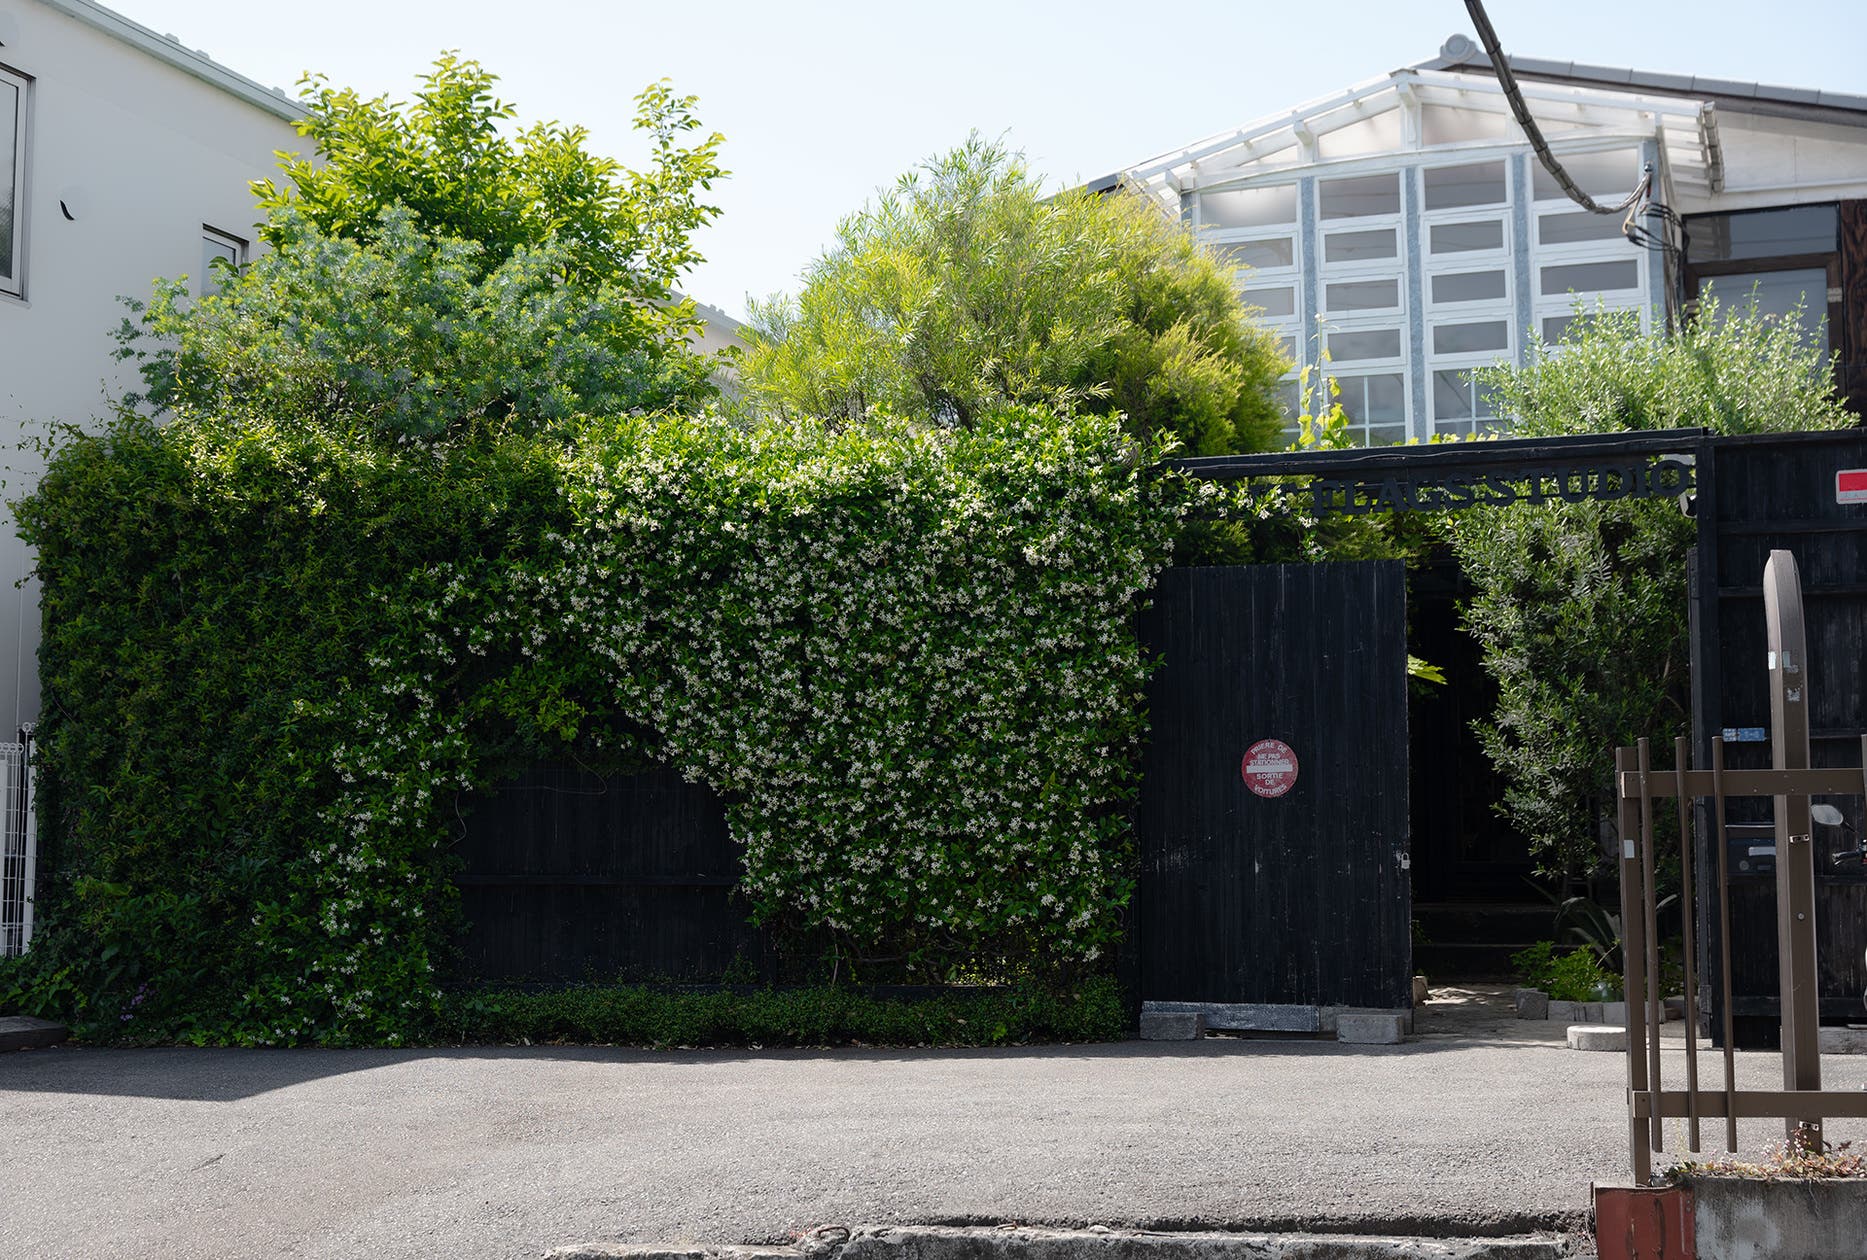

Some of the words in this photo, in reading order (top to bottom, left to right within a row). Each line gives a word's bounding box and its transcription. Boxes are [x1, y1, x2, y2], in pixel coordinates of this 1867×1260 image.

[1312, 471, 1476, 518] FLAGS
[1485, 459, 1690, 507] STUDIO
[1251, 742, 1275, 755] PRIERE
[1277, 744, 1288, 754] DE
[1254, 784, 1287, 795] VOITURES
